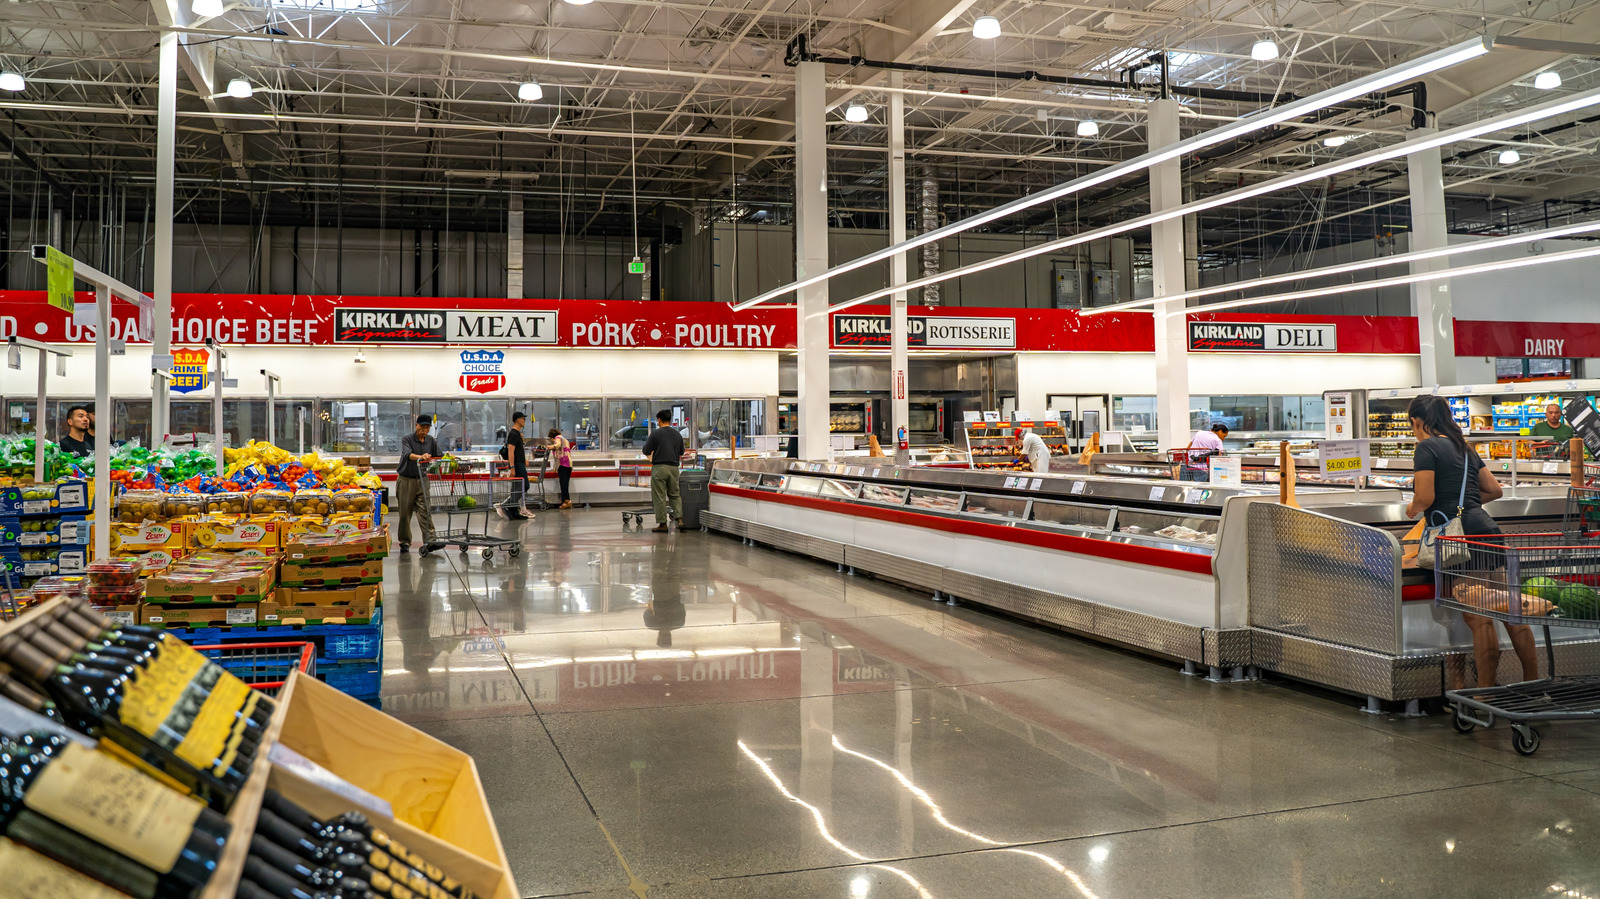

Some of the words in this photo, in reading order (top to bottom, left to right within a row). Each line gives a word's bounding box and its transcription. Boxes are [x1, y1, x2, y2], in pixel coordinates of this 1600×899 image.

[341, 312, 444, 329] KIRKLAND
[456, 315, 546, 338] MEAT
[840, 318, 924, 334] KIRKLD
[169, 317, 247, 343] HOICE
[256, 318, 319, 344] BEEF
[340, 327, 443, 342] Signature
[572, 322, 637, 346] PORK
[675, 323, 777, 347] POULTRY
[929, 325, 1011, 340] ROTISSERIE
[1193, 325, 1263, 339] KIRKLAND
[1276, 328, 1324, 347] DELI
[839, 332, 924, 346] Signate
[1193, 337, 1263, 350] Signature
[1524, 338, 1565, 357] DAIRY
[173, 352, 206, 364] .S.D.A.
[463, 353, 502, 361] U.S.D.A.
[170, 365, 203, 374] RIME
[464, 364, 501, 372] CHOICE
[169, 376, 201, 387] BEEF
[470, 376, 495, 390] Grade
[1326, 461, 1345, 470] $4.00
[1347, 459, 1361, 468] OFF
[145, 530, 166, 541] Zespri
[240, 530, 261, 540] Zespri
[146, 556, 167, 566] Zespri
